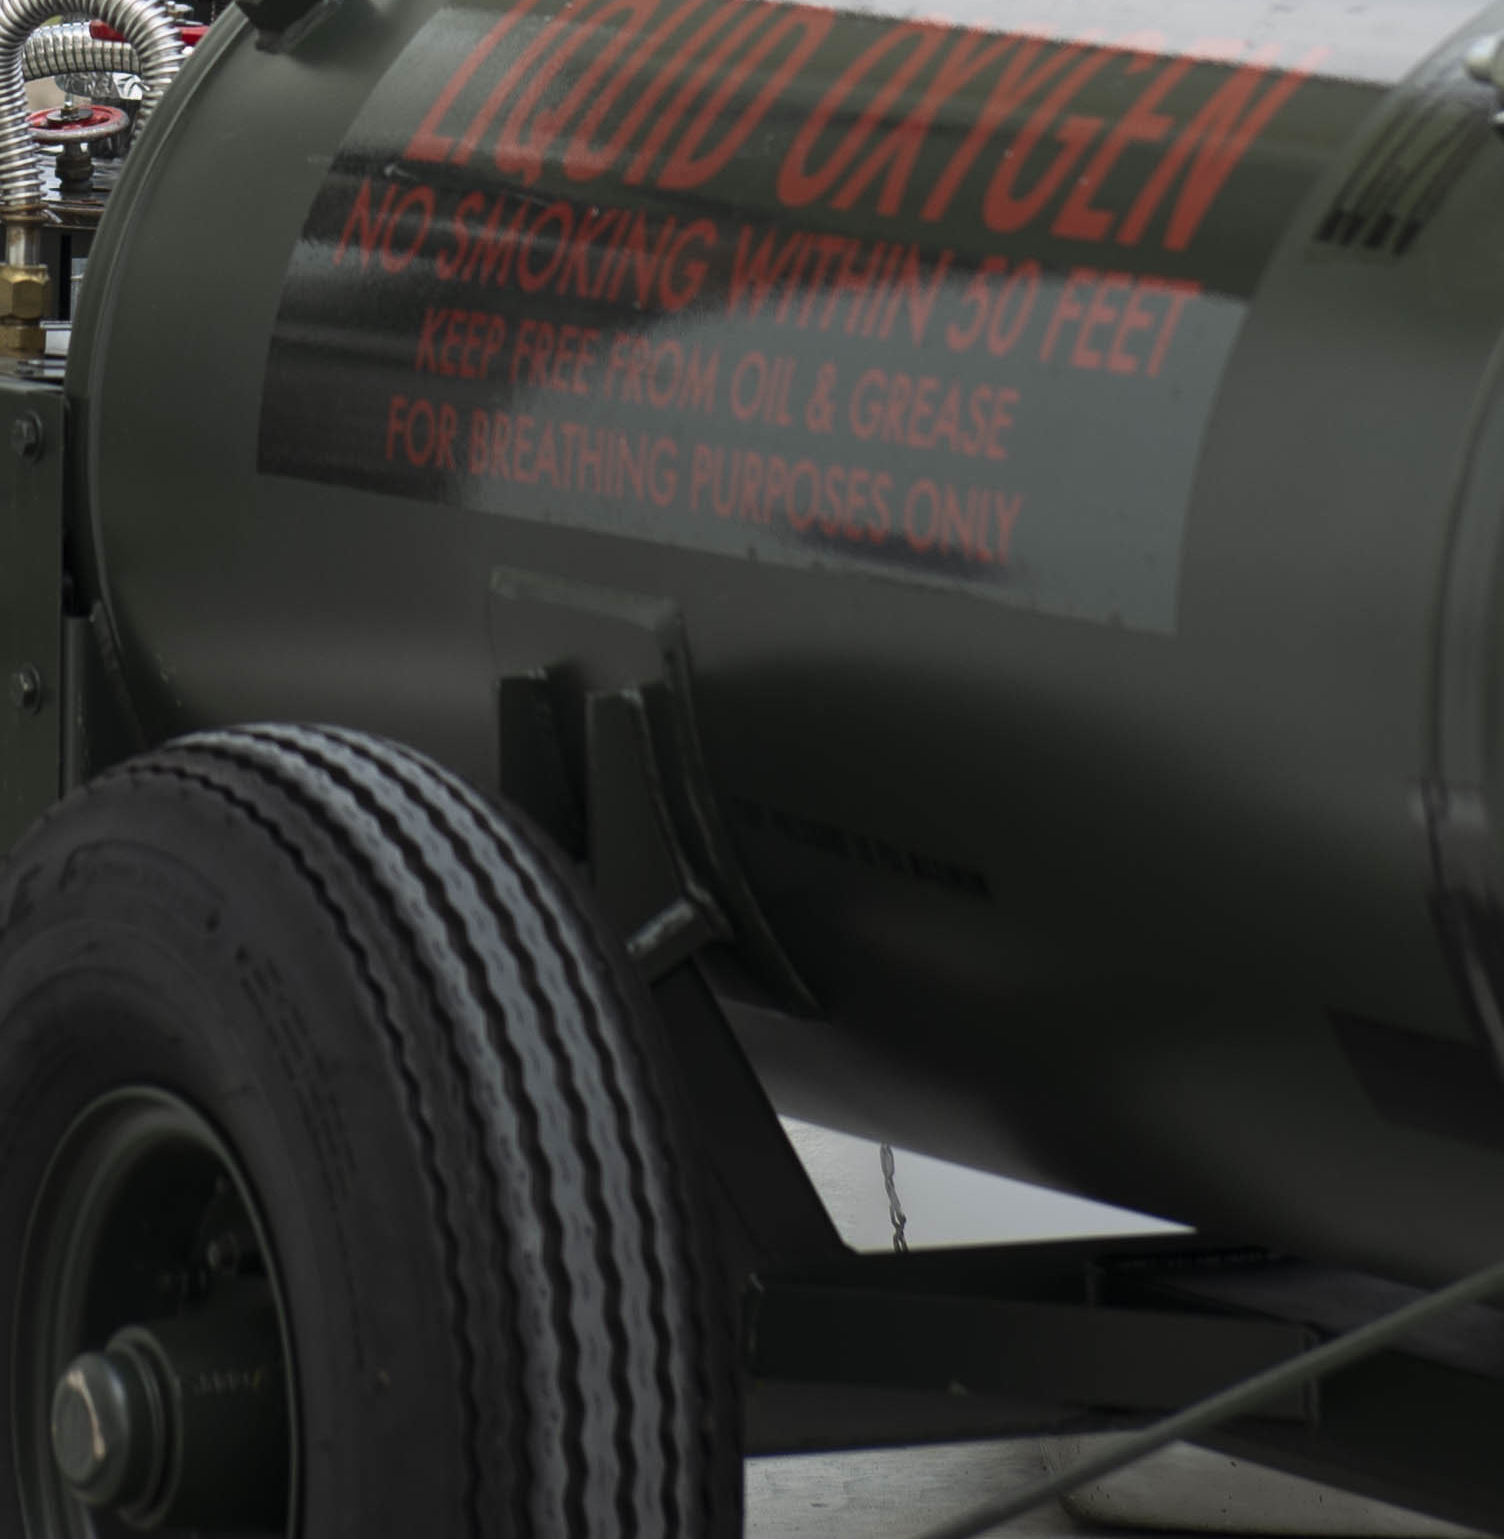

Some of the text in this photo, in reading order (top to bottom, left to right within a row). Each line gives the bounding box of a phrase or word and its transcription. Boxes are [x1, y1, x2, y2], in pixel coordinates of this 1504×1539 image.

[777, 15, 1332, 249] OXYGEN
[333, 178, 1204, 379] NO SMOKING WITHIN 50 FEET
[415, 306, 1022, 460] KEEP FREE FROM OIL & GREASE
[386, 394, 1025, 566] FOR BREATHING PURPOSES ONLY
